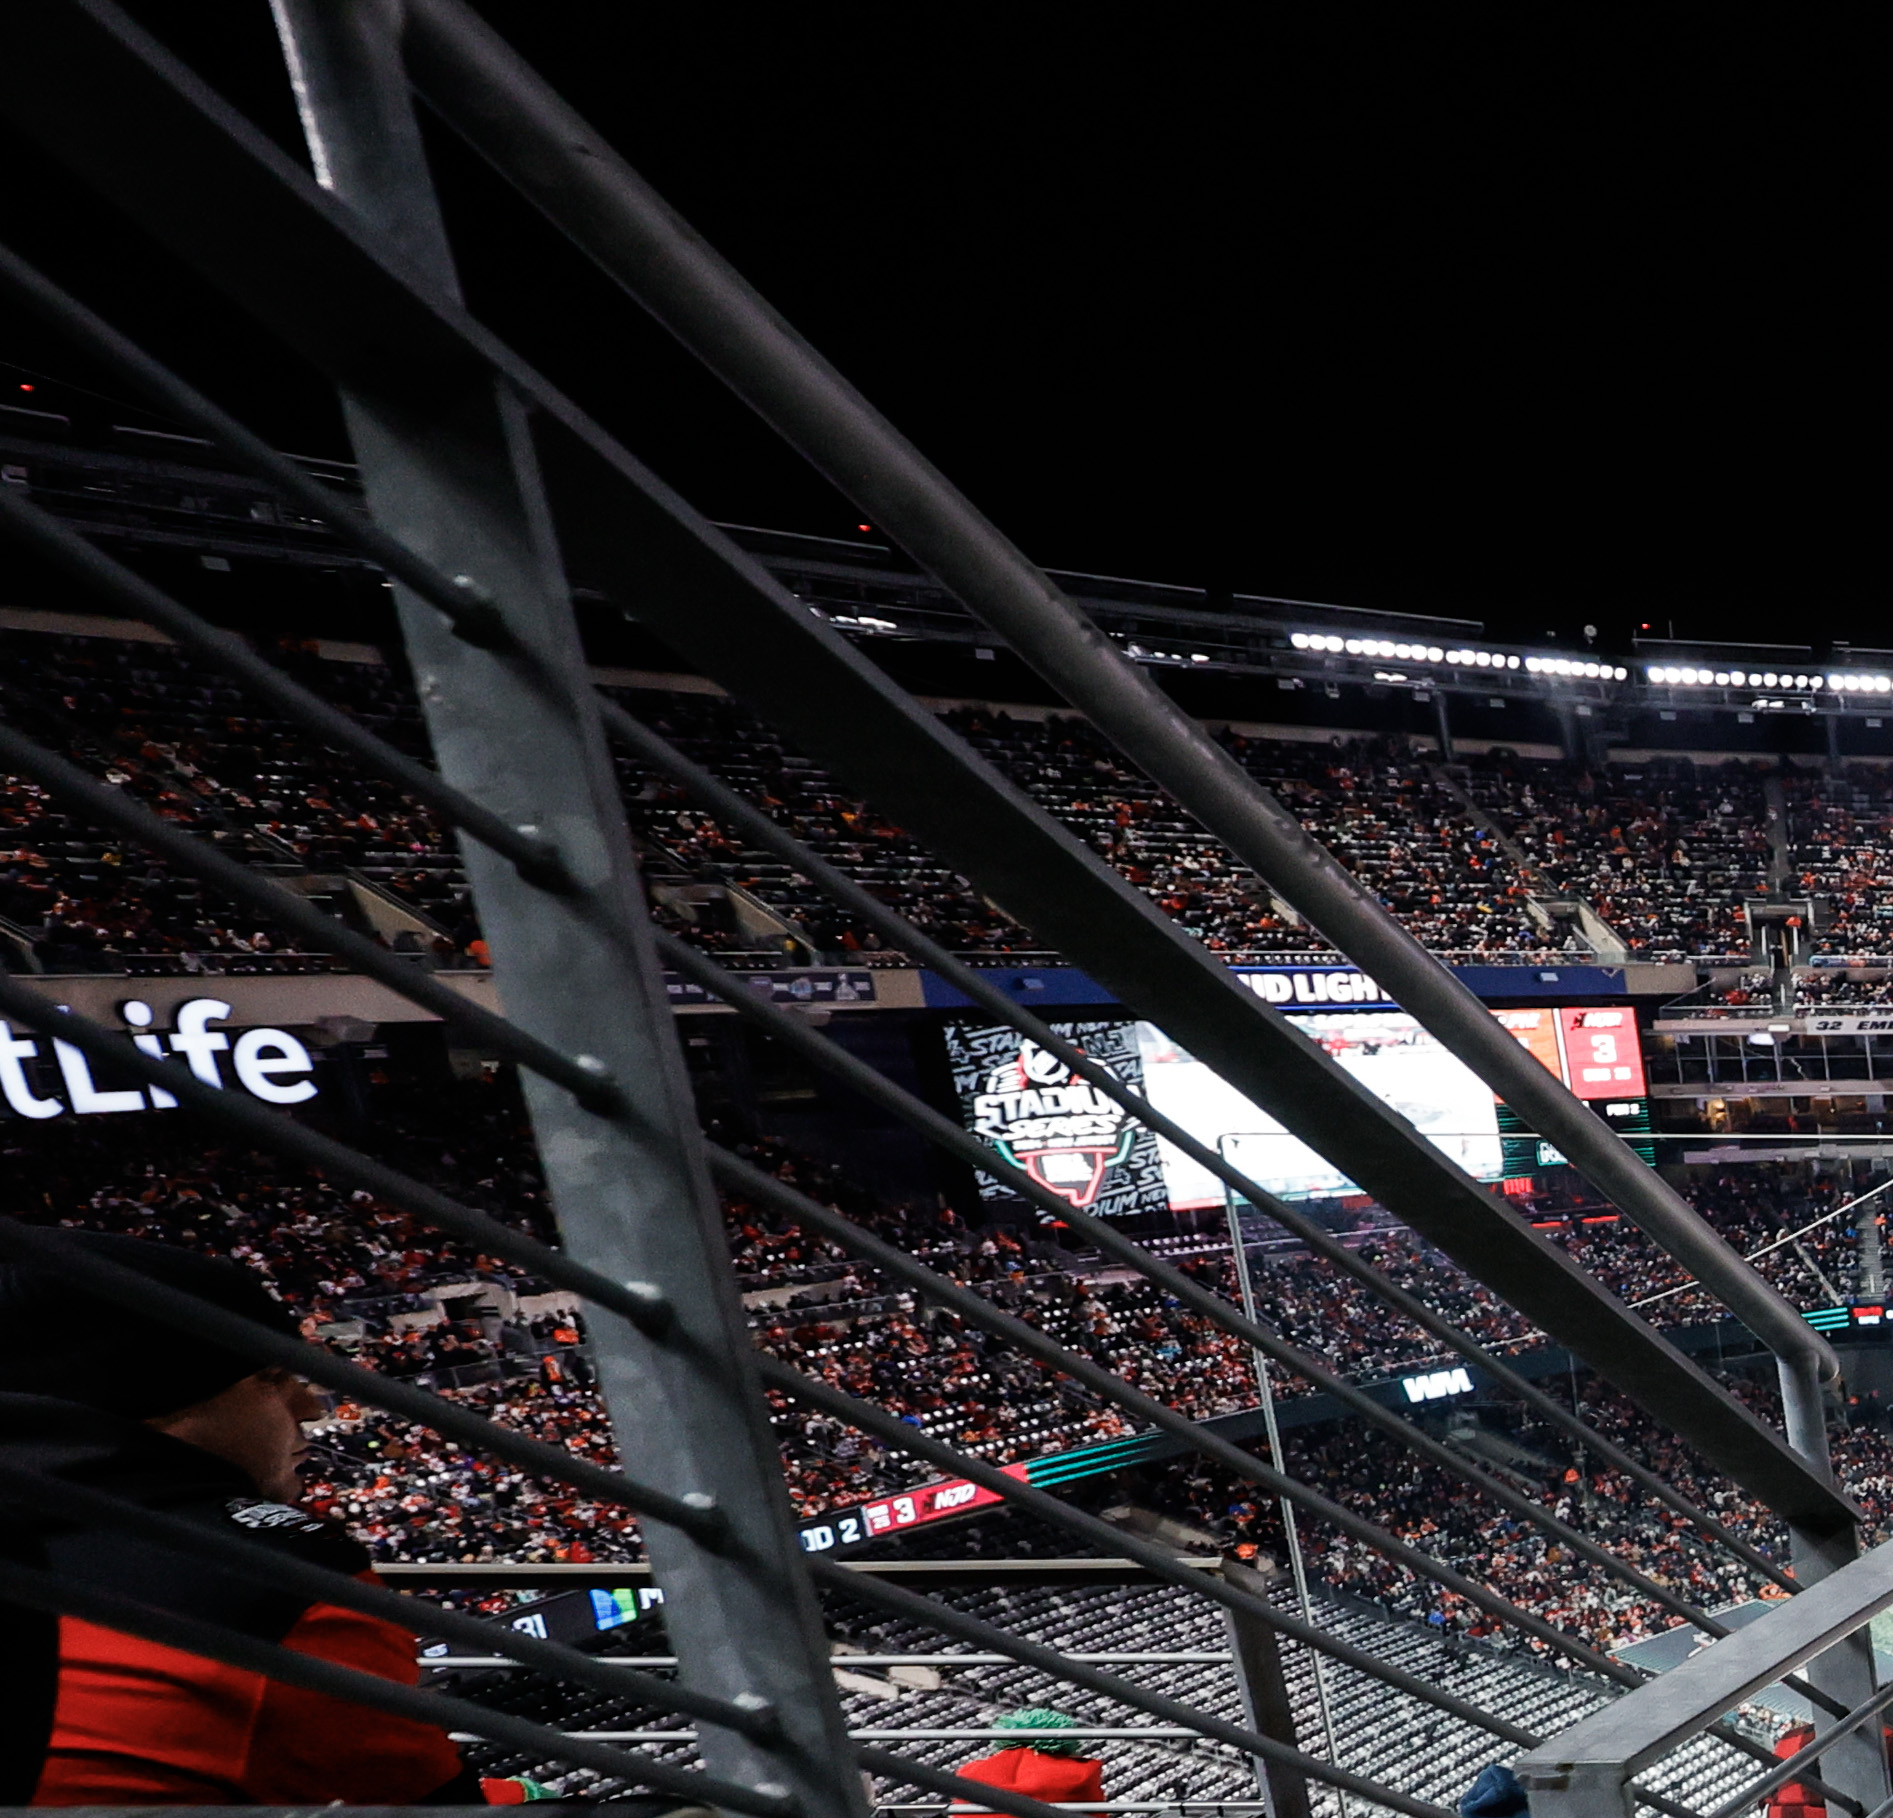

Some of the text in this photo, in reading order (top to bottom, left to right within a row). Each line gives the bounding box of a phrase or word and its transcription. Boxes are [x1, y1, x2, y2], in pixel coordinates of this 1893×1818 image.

[1293, 973, 1393, 1003] LIGH
[1815, 1020, 1843, 1031] 32
[1590, 1034, 1617, 1064] 3
[1003, 1115, 1122, 1139] SERIES
[838, 1518, 861, 1544] 2
[893, 1497, 916, 1524] 3
[934, 1483, 977, 1510] NJD
